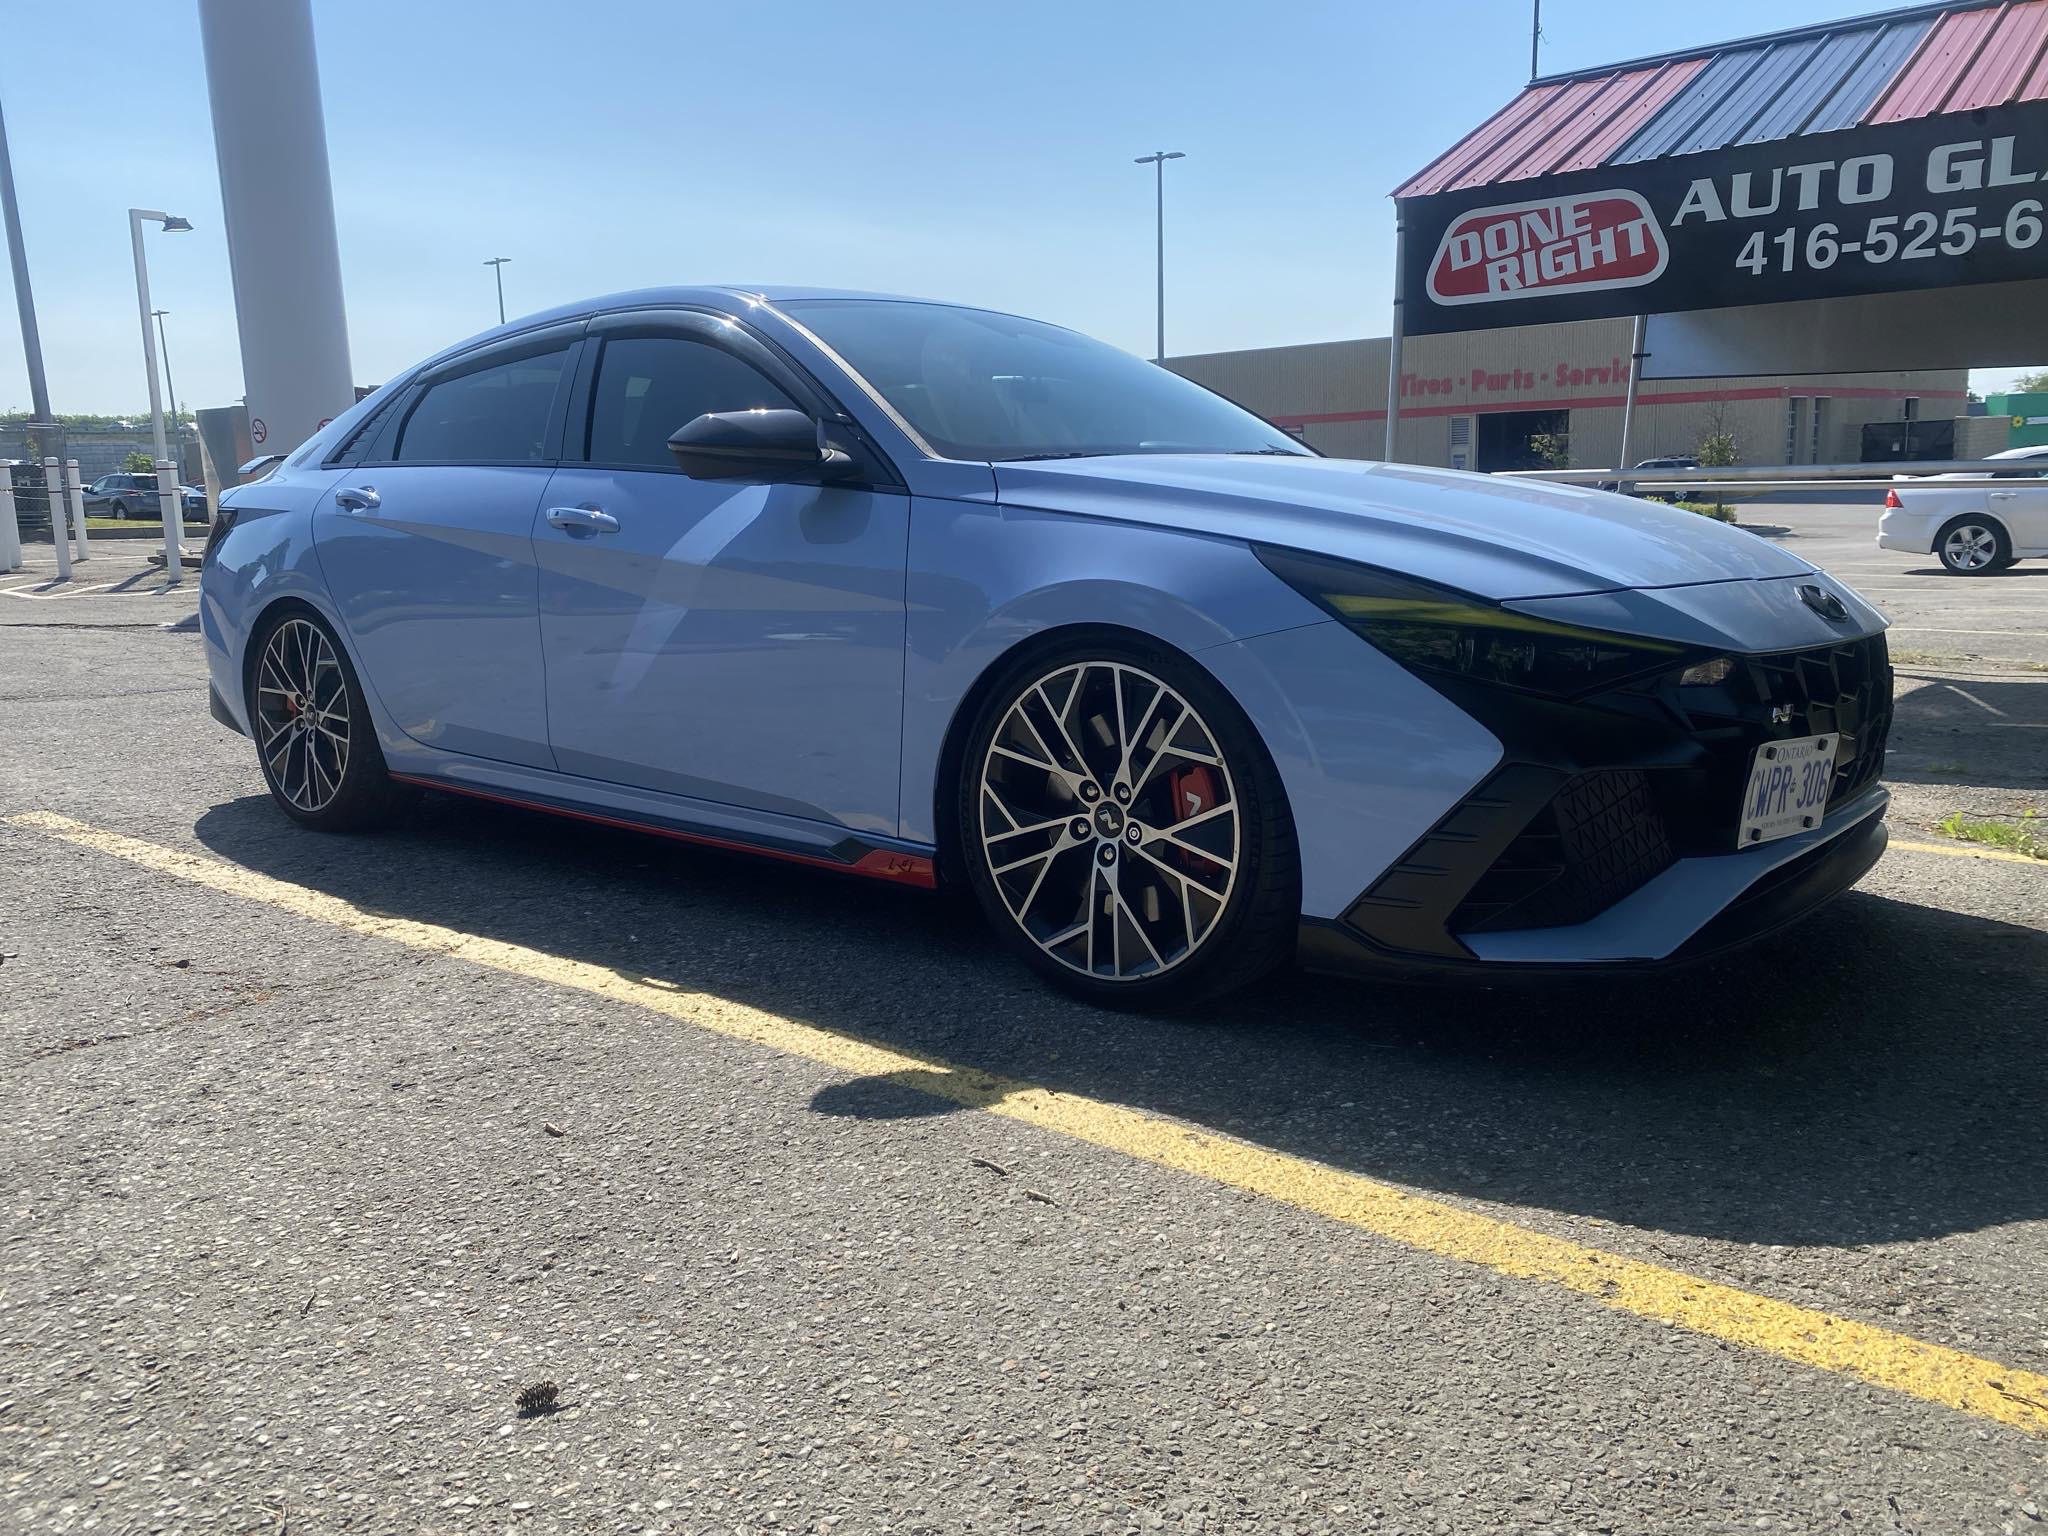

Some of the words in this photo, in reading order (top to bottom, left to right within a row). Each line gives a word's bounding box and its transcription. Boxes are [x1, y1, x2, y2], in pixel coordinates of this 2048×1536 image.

[1670, 152, 1895, 227] AUTO
[1926, 135, 2048, 194] GL
[1450, 201, 1593, 272] DONE
[1485, 216, 1648, 293] RIGHT
[1735, 199, 2045, 276] 416-525-6
[1400, 372, 1453, 397] Tires
[1471, 368, 1535, 392] Parts
[1556, 357, 1632, 388] Servic
[1747, 764, 1793, 820] CWPR
[1796, 758, 1832, 809] 306
